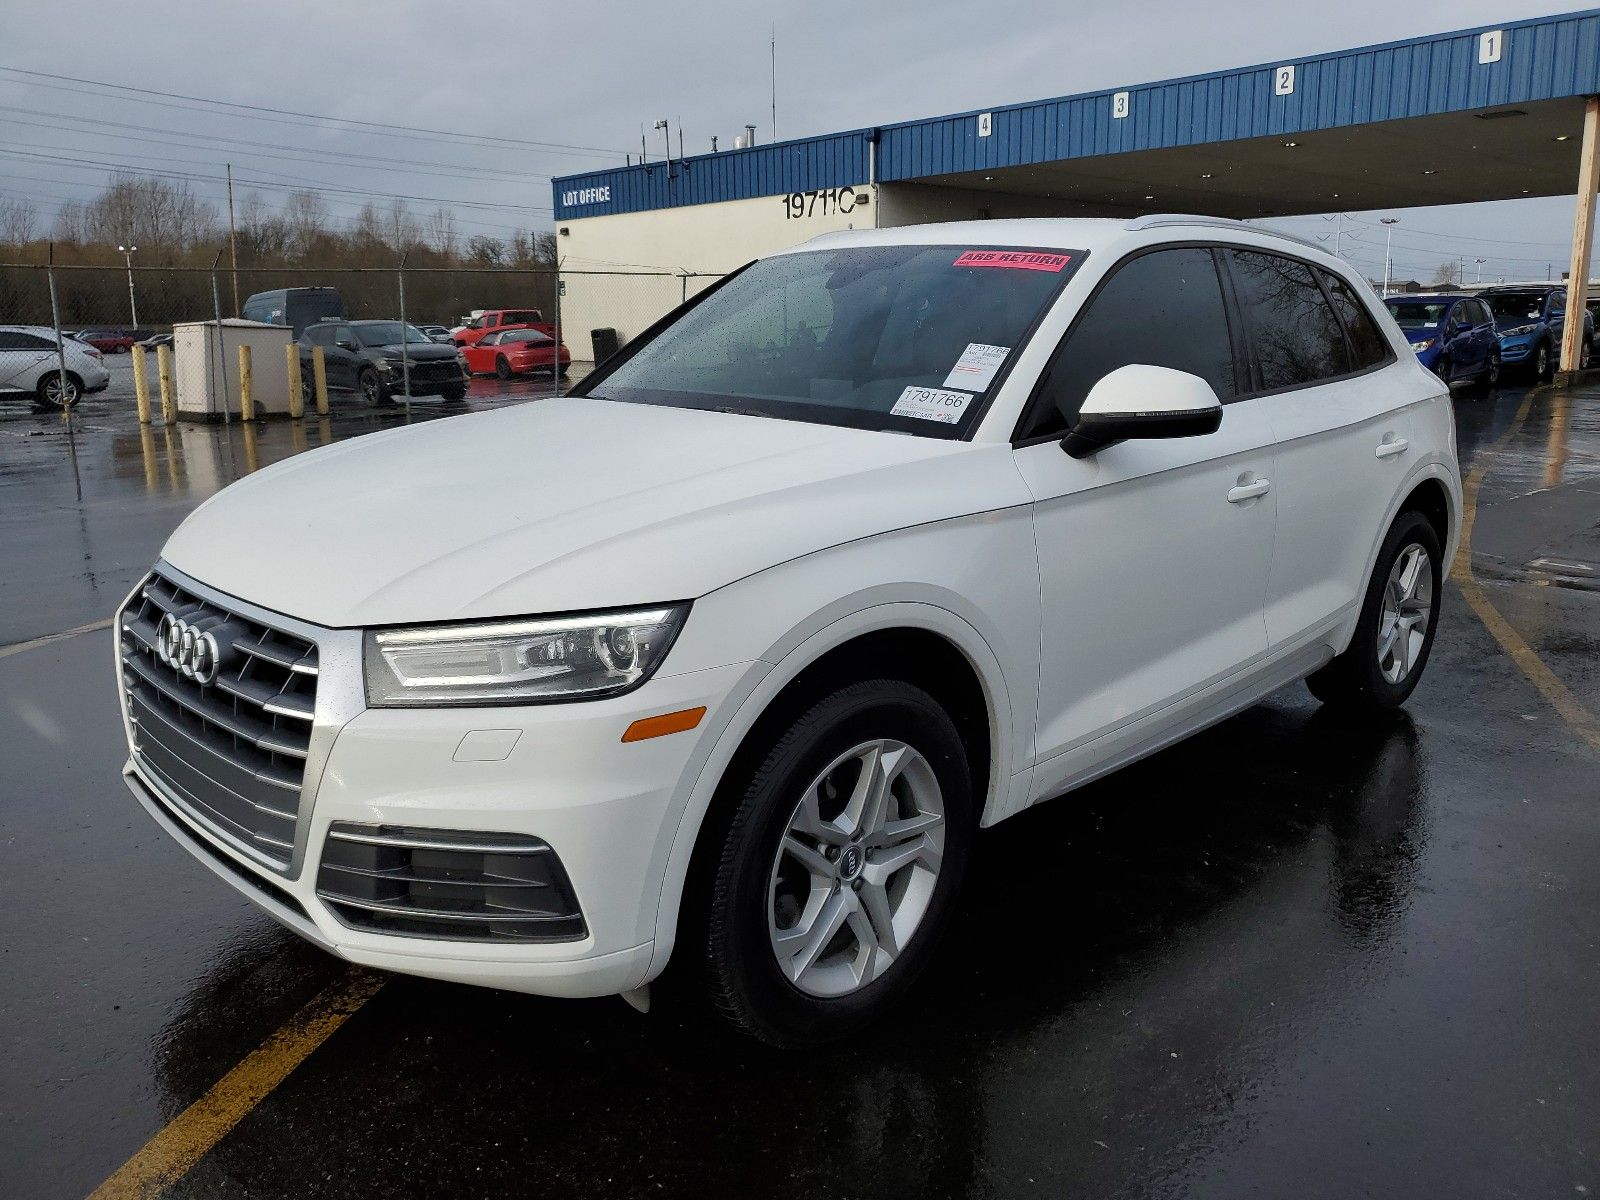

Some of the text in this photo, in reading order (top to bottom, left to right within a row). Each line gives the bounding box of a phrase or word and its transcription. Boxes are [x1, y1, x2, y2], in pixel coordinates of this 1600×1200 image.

[1487, 37, 1494, 57] 1
[1281, 71, 1290, 89] 2
[1117, 97, 1125, 113] 3
[982, 117, 989, 132] 4
[562, 186, 610, 206] LOT OFFICE
[781, 186, 856, 219] 19711C
[999, 253, 1066, 266] RETURN
[967, 344, 1010, 355] 1791766
[904, 389, 965, 408] 1791766
